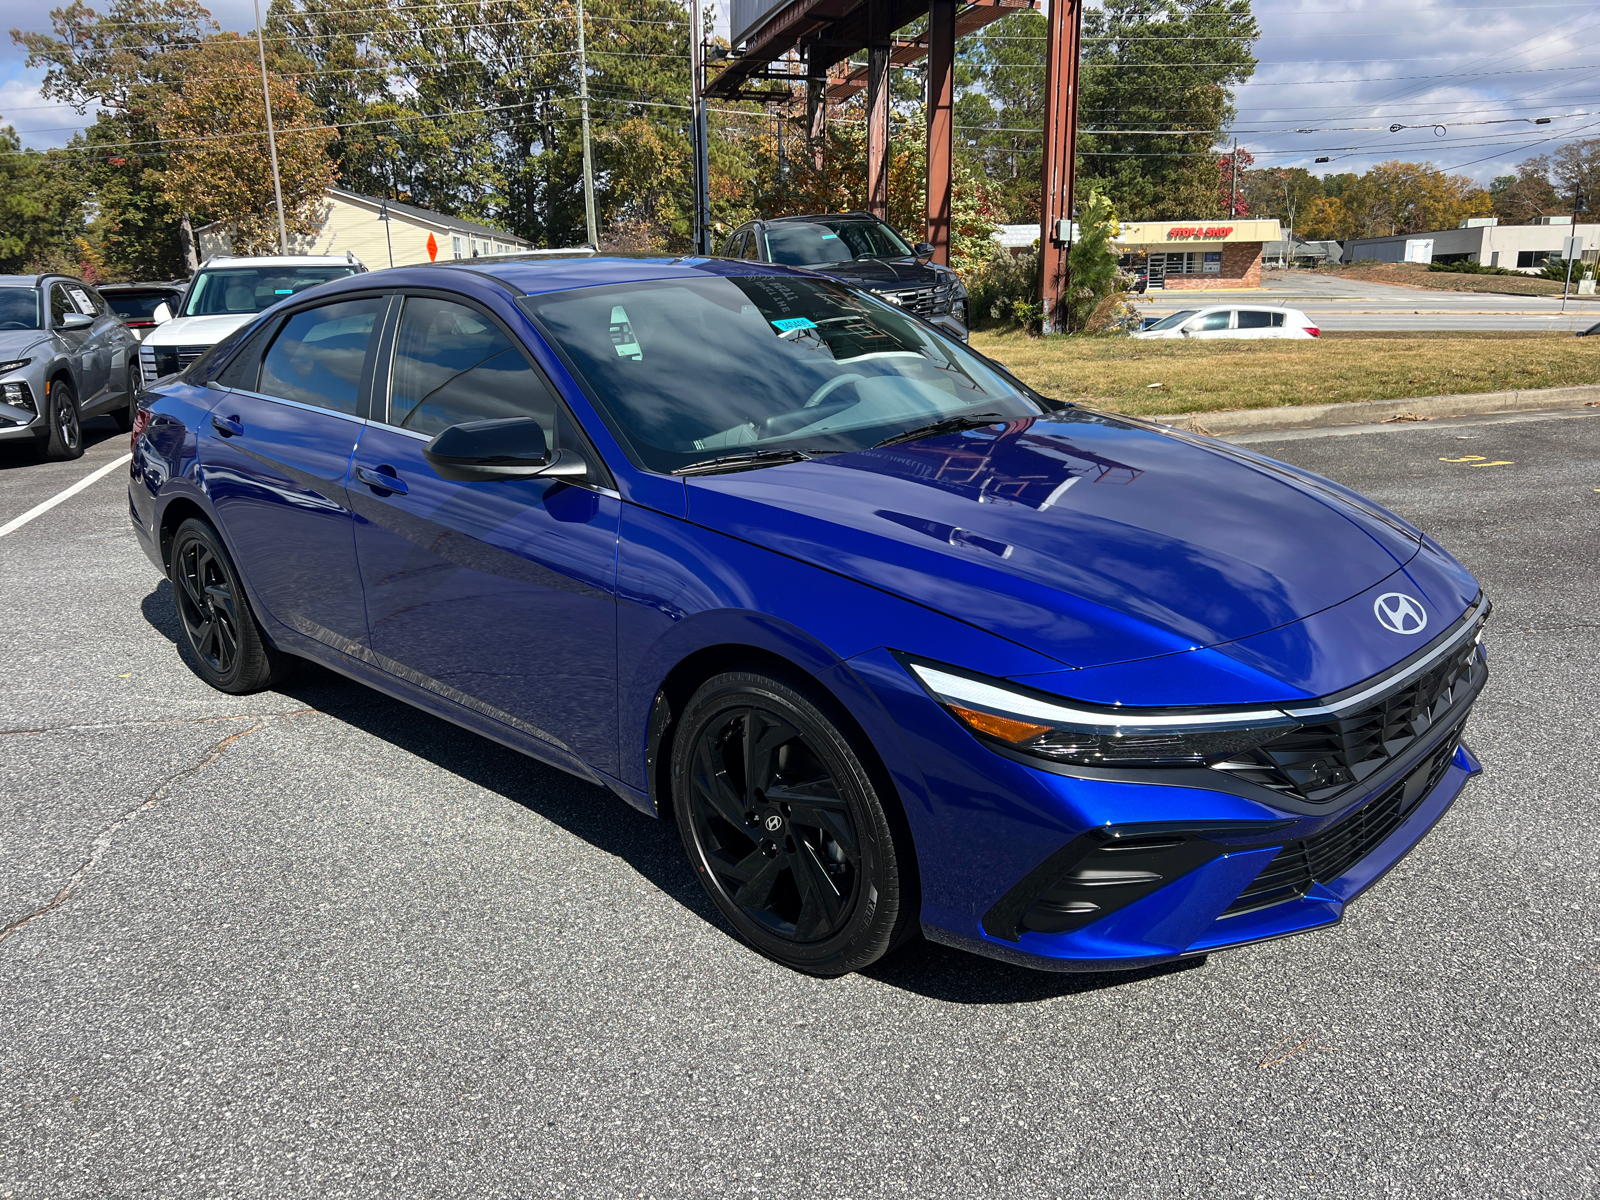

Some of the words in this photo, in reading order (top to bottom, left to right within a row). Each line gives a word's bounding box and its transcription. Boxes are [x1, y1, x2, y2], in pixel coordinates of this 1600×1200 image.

[1170, 227, 1196, 237] STOP
[1197, 227, 1205, 237] &
[1206, 226, 1233, 237] SHOP
